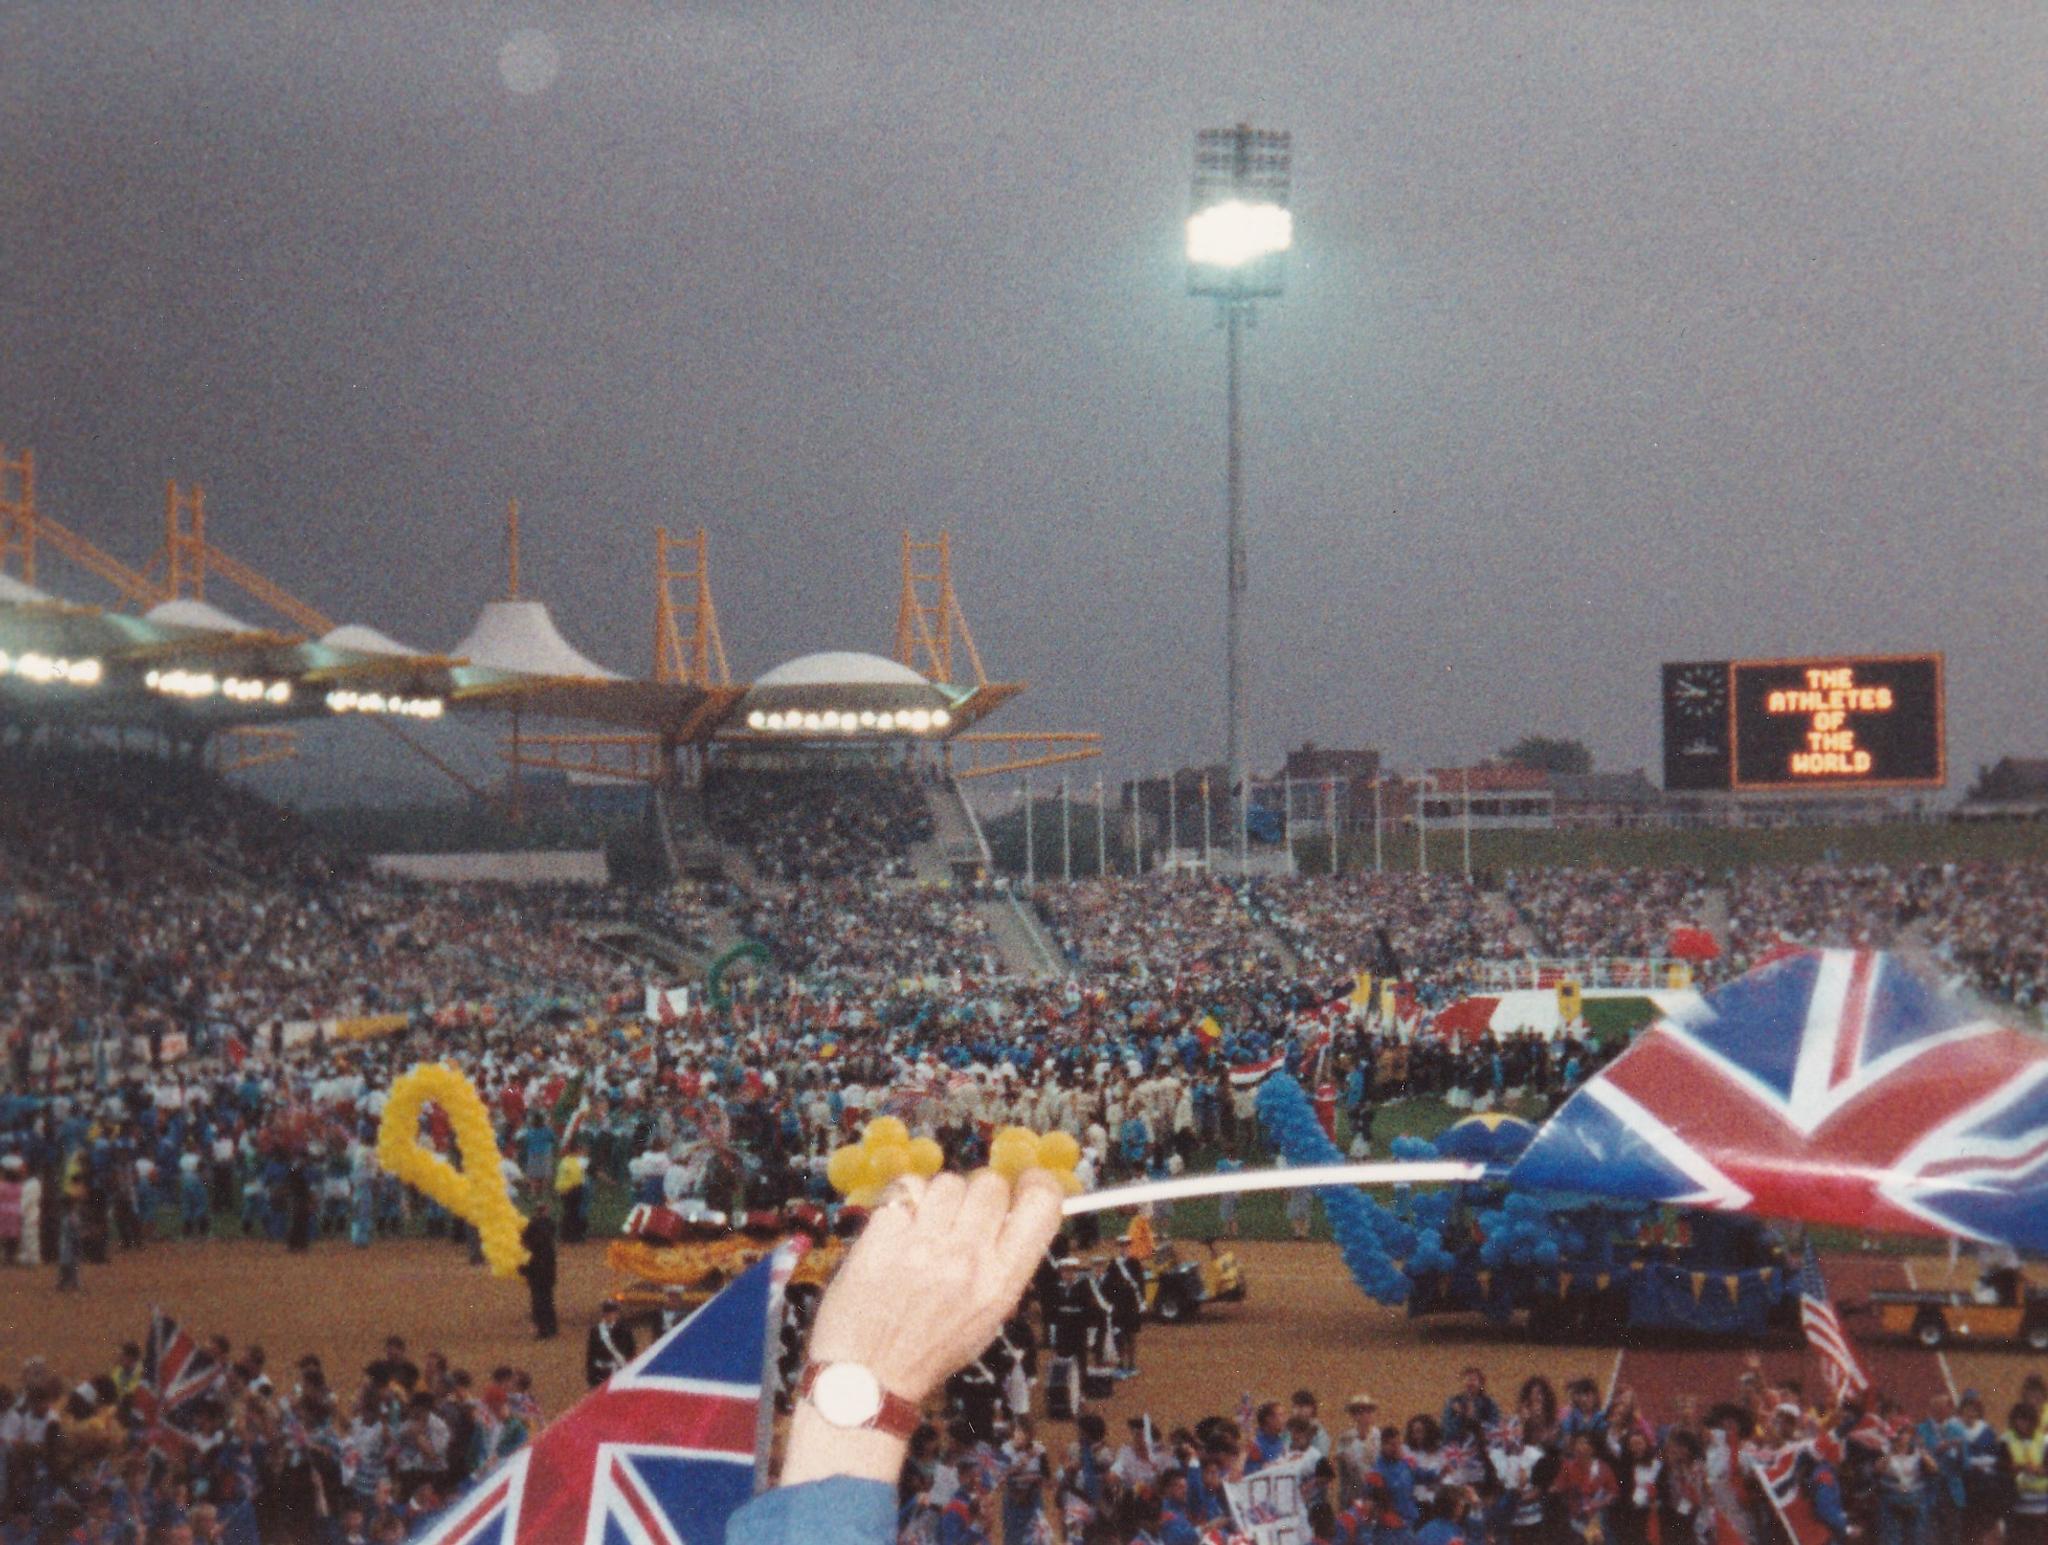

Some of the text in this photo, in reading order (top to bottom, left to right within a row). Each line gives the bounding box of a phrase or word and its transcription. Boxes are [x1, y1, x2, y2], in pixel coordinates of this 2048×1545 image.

[1806, 668, 1854, 689] THE
[1767, 687, 1893, 712] ATHLETES
[1812, 711, 1847, 731] OF
[1807, 731, 1856, 752] THE
[1791, 750, 1872, 774] WORLD
